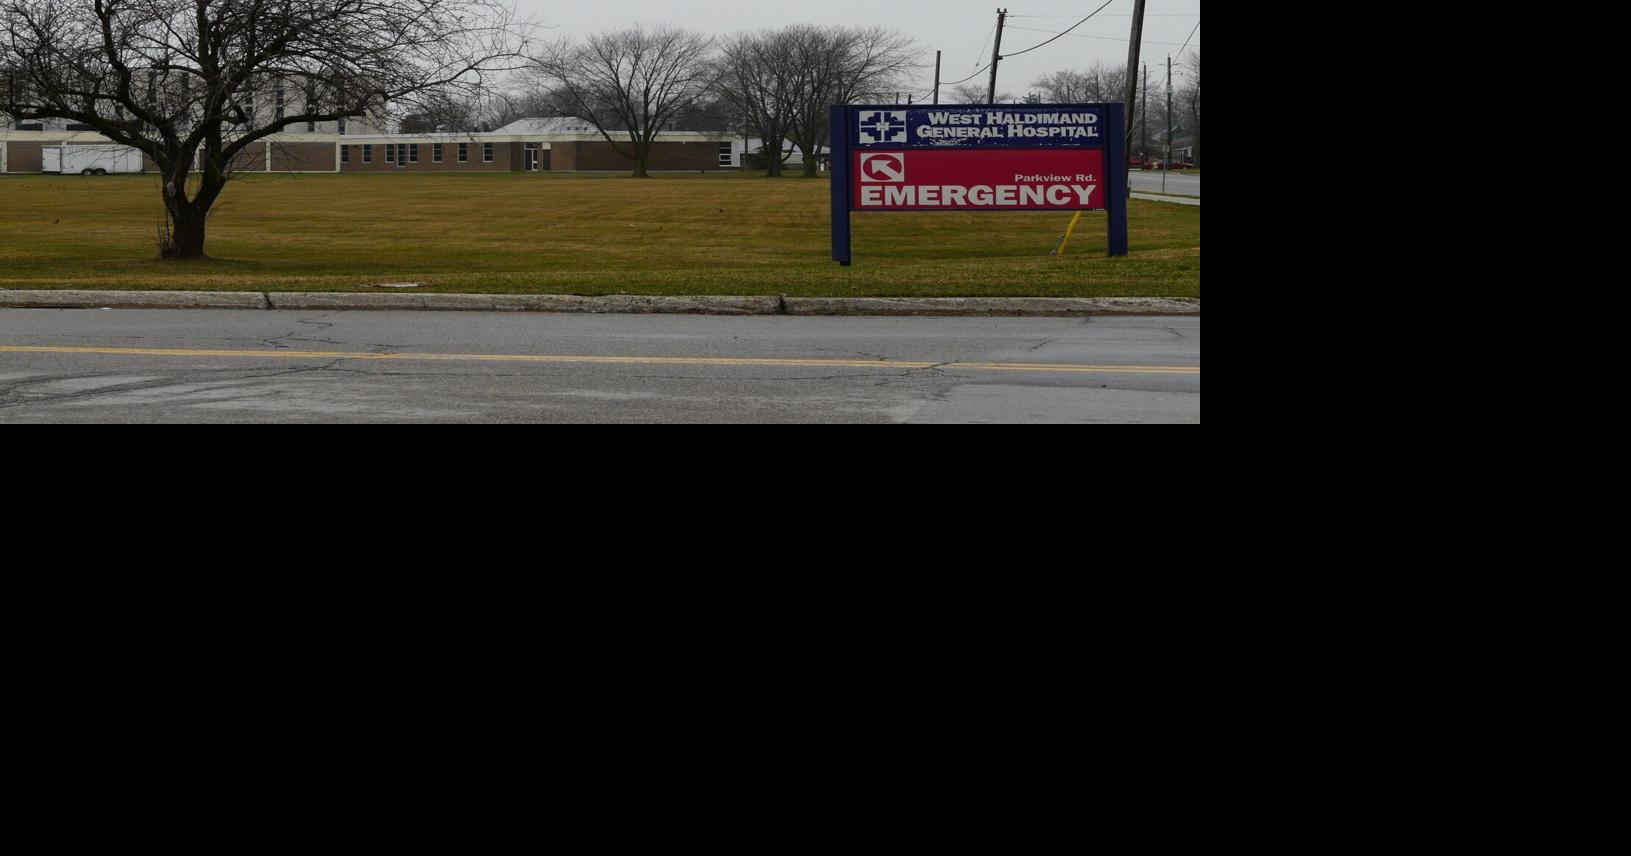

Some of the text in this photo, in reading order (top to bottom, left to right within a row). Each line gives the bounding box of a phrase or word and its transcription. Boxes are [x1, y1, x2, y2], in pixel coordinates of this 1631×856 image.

[928, 111, 1098, 125] WEST HALDIMAND
[916, 124, 1098, 138] GENERAL HOSPITAL
[1014, 174, 1097, 183] Parkview Rd.
[860, 184, 1096, 206] EMERGENCY
